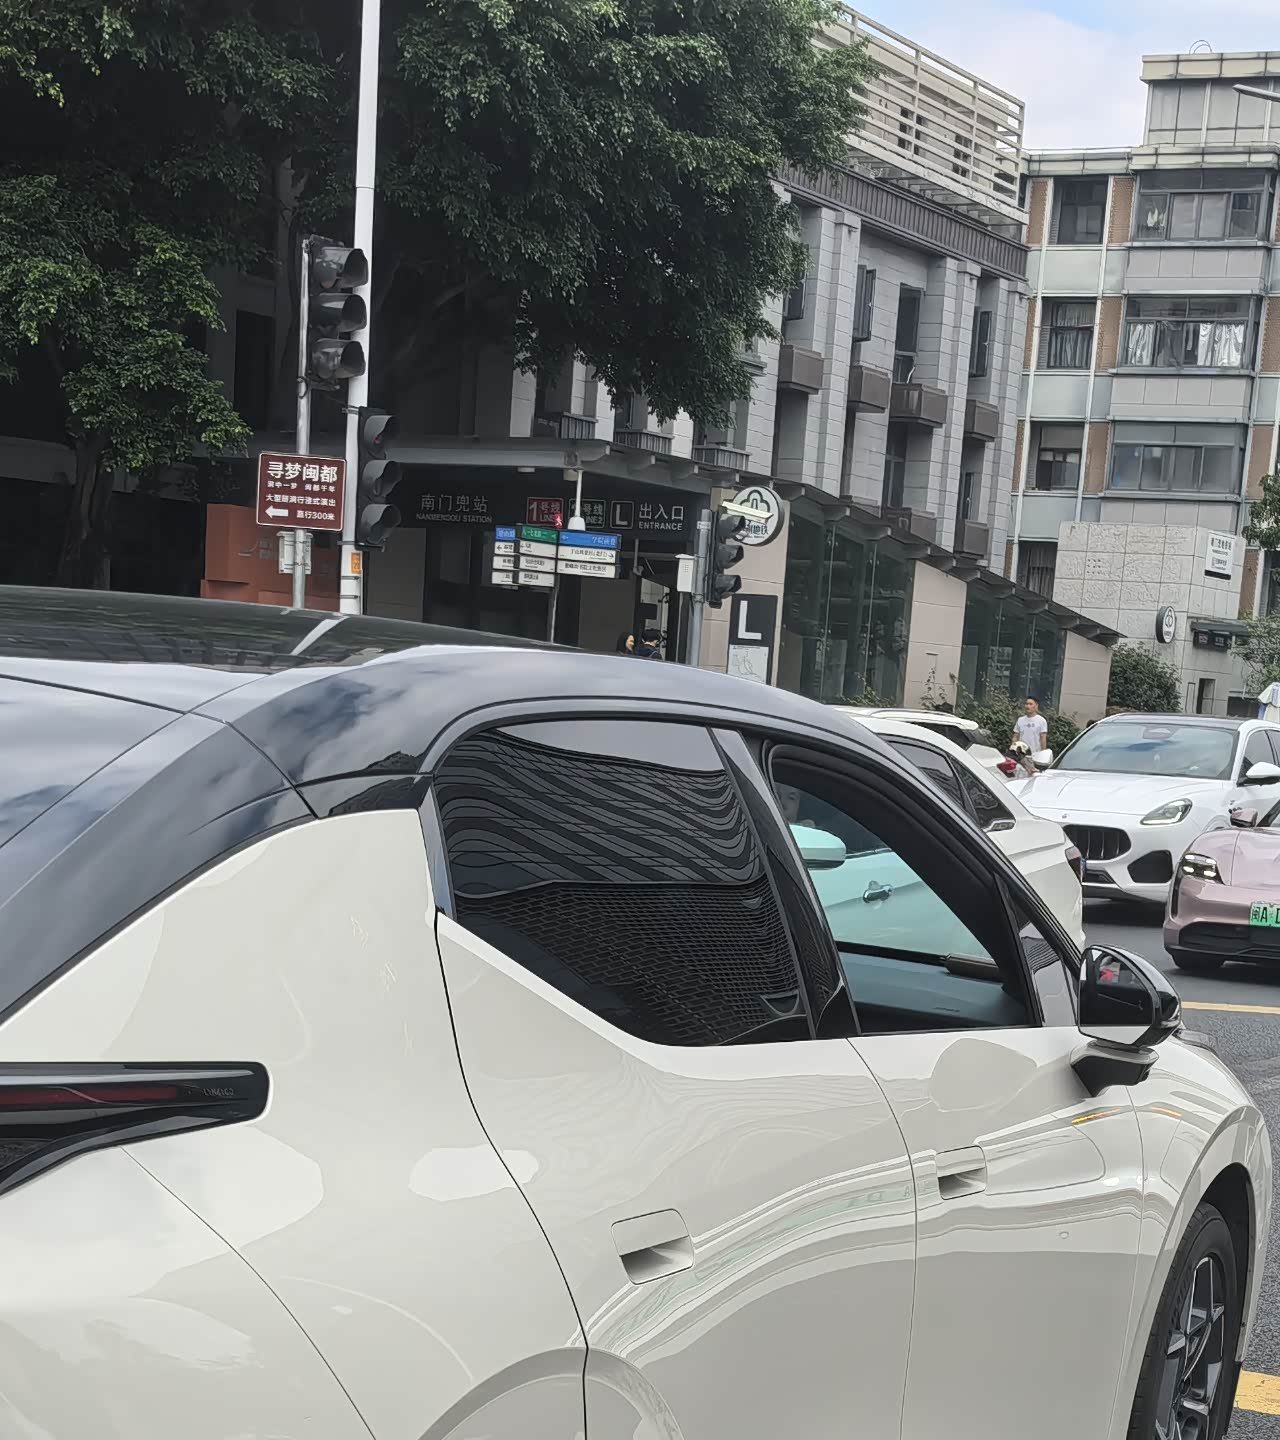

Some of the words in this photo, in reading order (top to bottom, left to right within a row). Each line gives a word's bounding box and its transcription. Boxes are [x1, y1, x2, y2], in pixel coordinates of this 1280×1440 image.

[267, 461, 338, 483] 寻梦闽都
[421, 493, 489, 513] 南门兜站
[638, 502, 684, 520] 出入口
[296, 510, 335, 520] 直行300米
[615, 504, 628, 526] L
[638, 521, 683, 531] ENTRANCE
[737, 600, 762, 640] L
